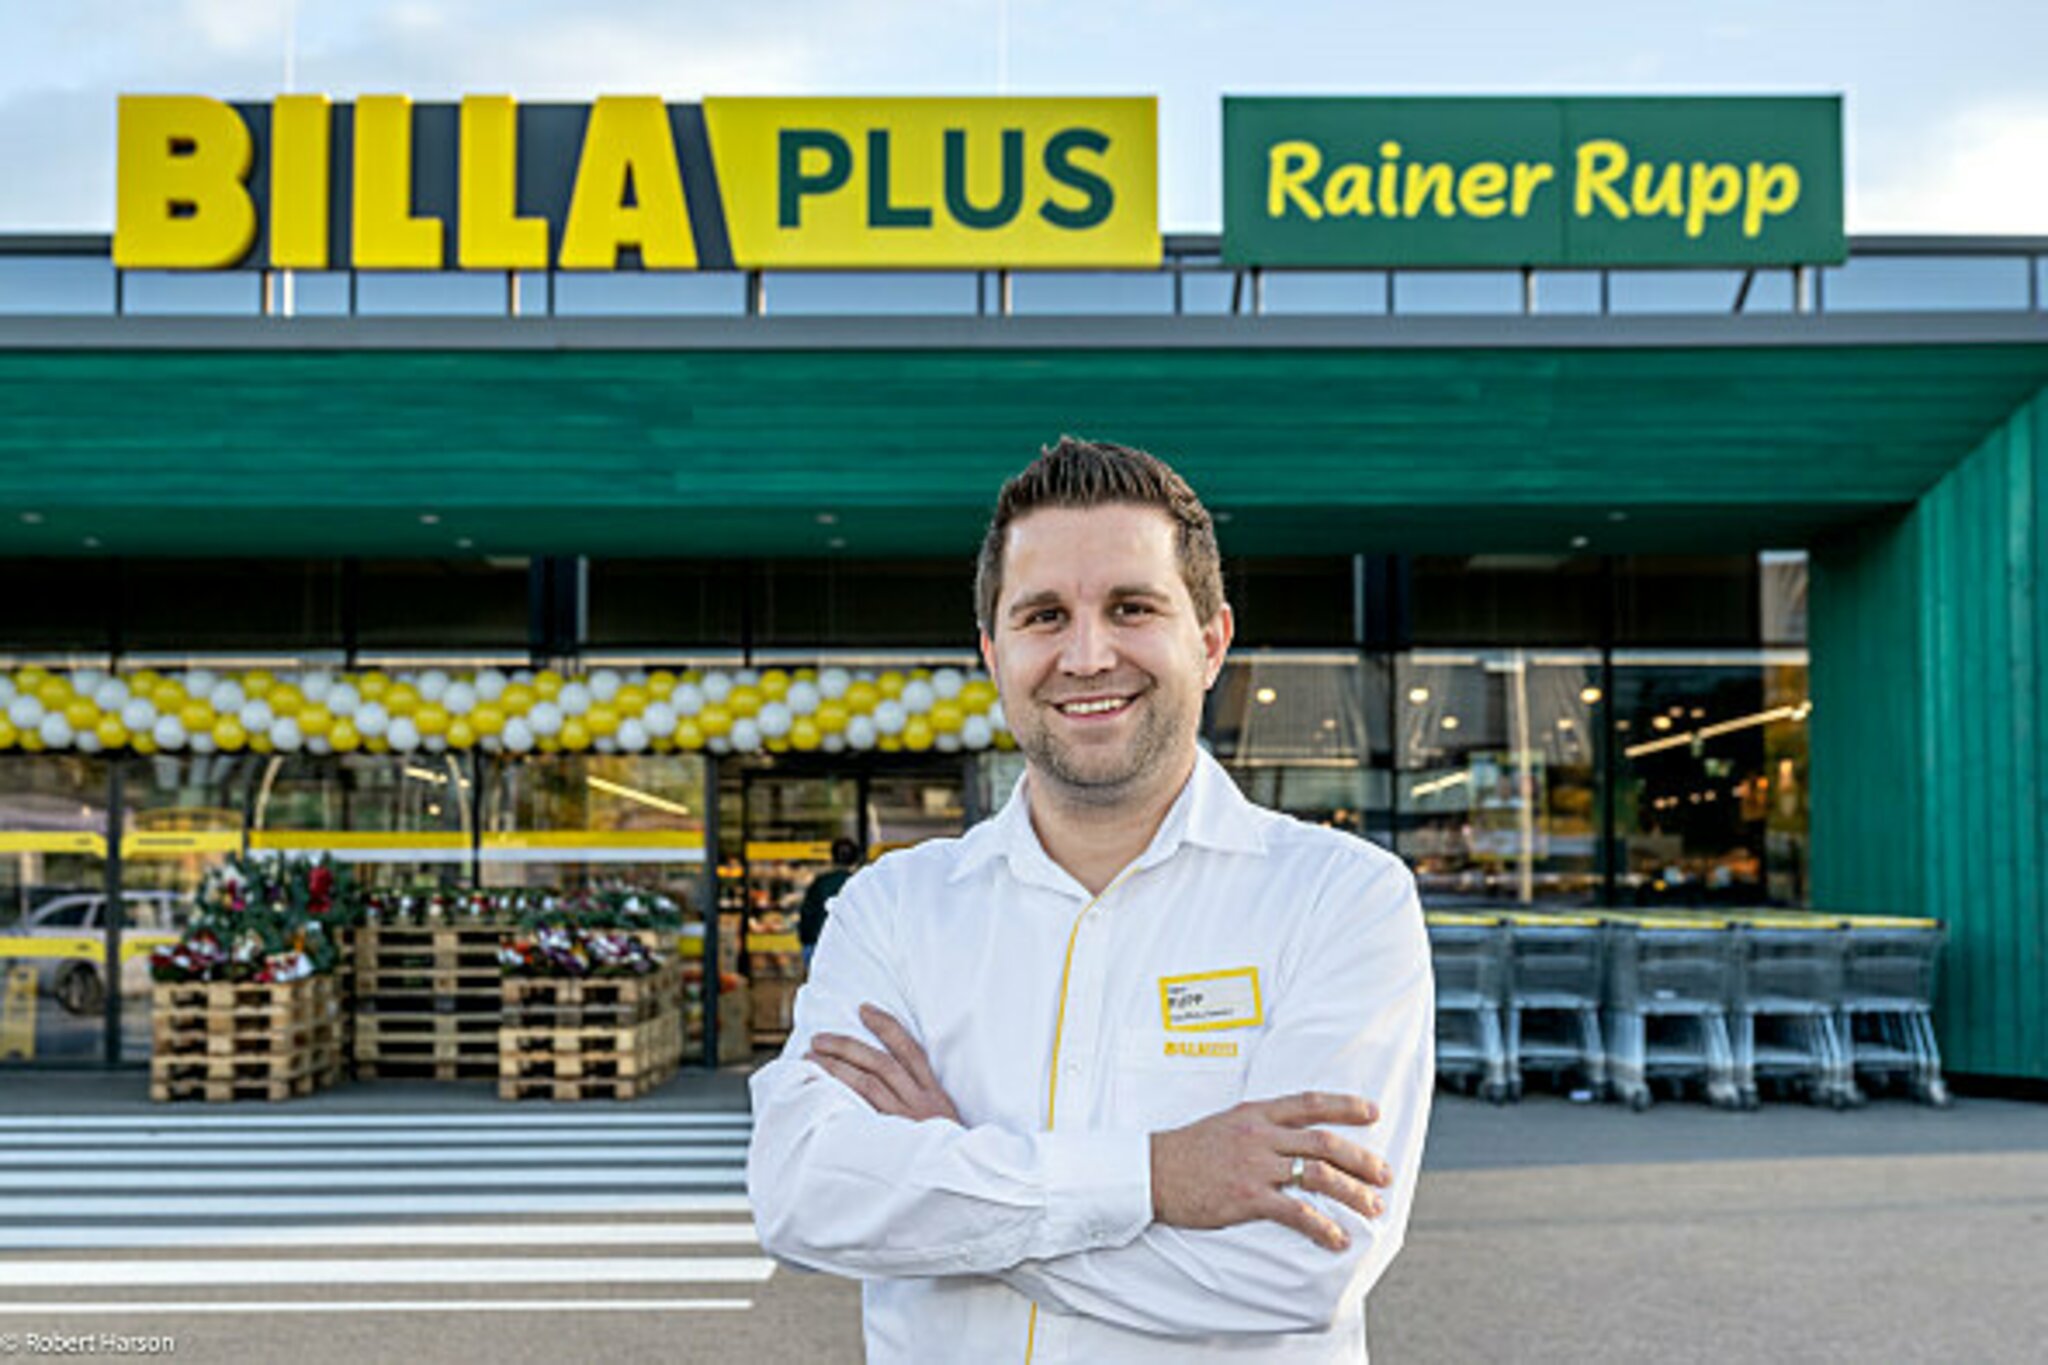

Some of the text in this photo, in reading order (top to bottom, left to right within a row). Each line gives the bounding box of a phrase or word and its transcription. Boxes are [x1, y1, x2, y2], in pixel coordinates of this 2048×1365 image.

[113, 94, 1115, 269] BILLA PLUS
[1267, 139, 1801, 237] Rainer Rupp
